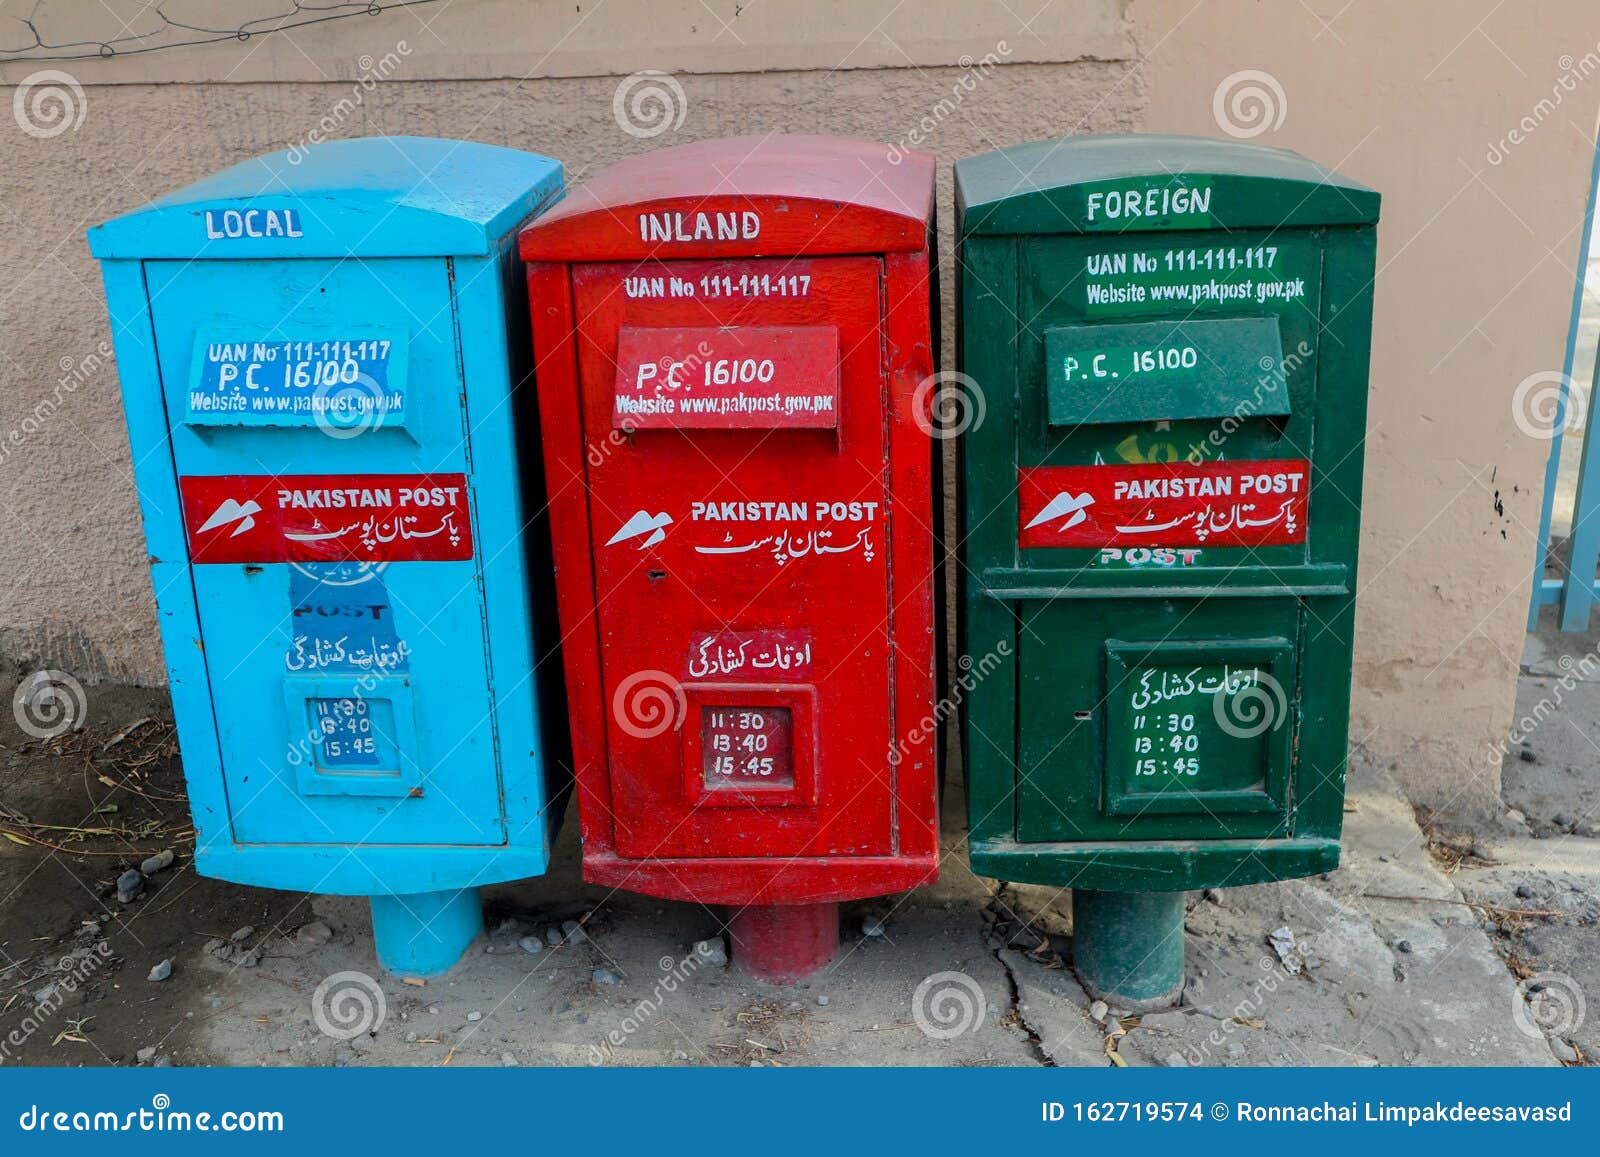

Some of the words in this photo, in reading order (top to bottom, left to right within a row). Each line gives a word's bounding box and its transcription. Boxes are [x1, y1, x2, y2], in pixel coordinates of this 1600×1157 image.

[1088, 187, 1211, 220] FOREIGN
[205, 210, 303, 239] LOCAL
[640, 212, 760, 241] INLAND
[1087, 254, 1128, 275] UAN
[1134, 253, 1157, 272] No
[1165, 247, 1278, 271] 111-111-117
[624, 277, 663, 297] UAN
[671, 277, 695, 296] No
[700, 275, 811, 297] 111-111-117
[1087, 283, 1146, 304] Website
[209, 344, 247, 362] UAN
[284, 341, 390, 361] 111-111-117
[1133, 347, 1198, 372] 16100
[284, 359, 358, 388] 16100
[705, 359, 774, 386] 16100
[190, 392, 247, 411] Website
[616, 394, 675, 414] Website
[277, 489, 392, 508] PAKISTAN
[399, 488, 460, 506] POST
[1115, 477, 1232, 500] PAKISTAN
[1240, 473, 1303, 494] POST
[692, 502, 808, 521] PAKISTAN
[816, 502, 878, 521] POST
[1101, 547, 1202, 566] POST
